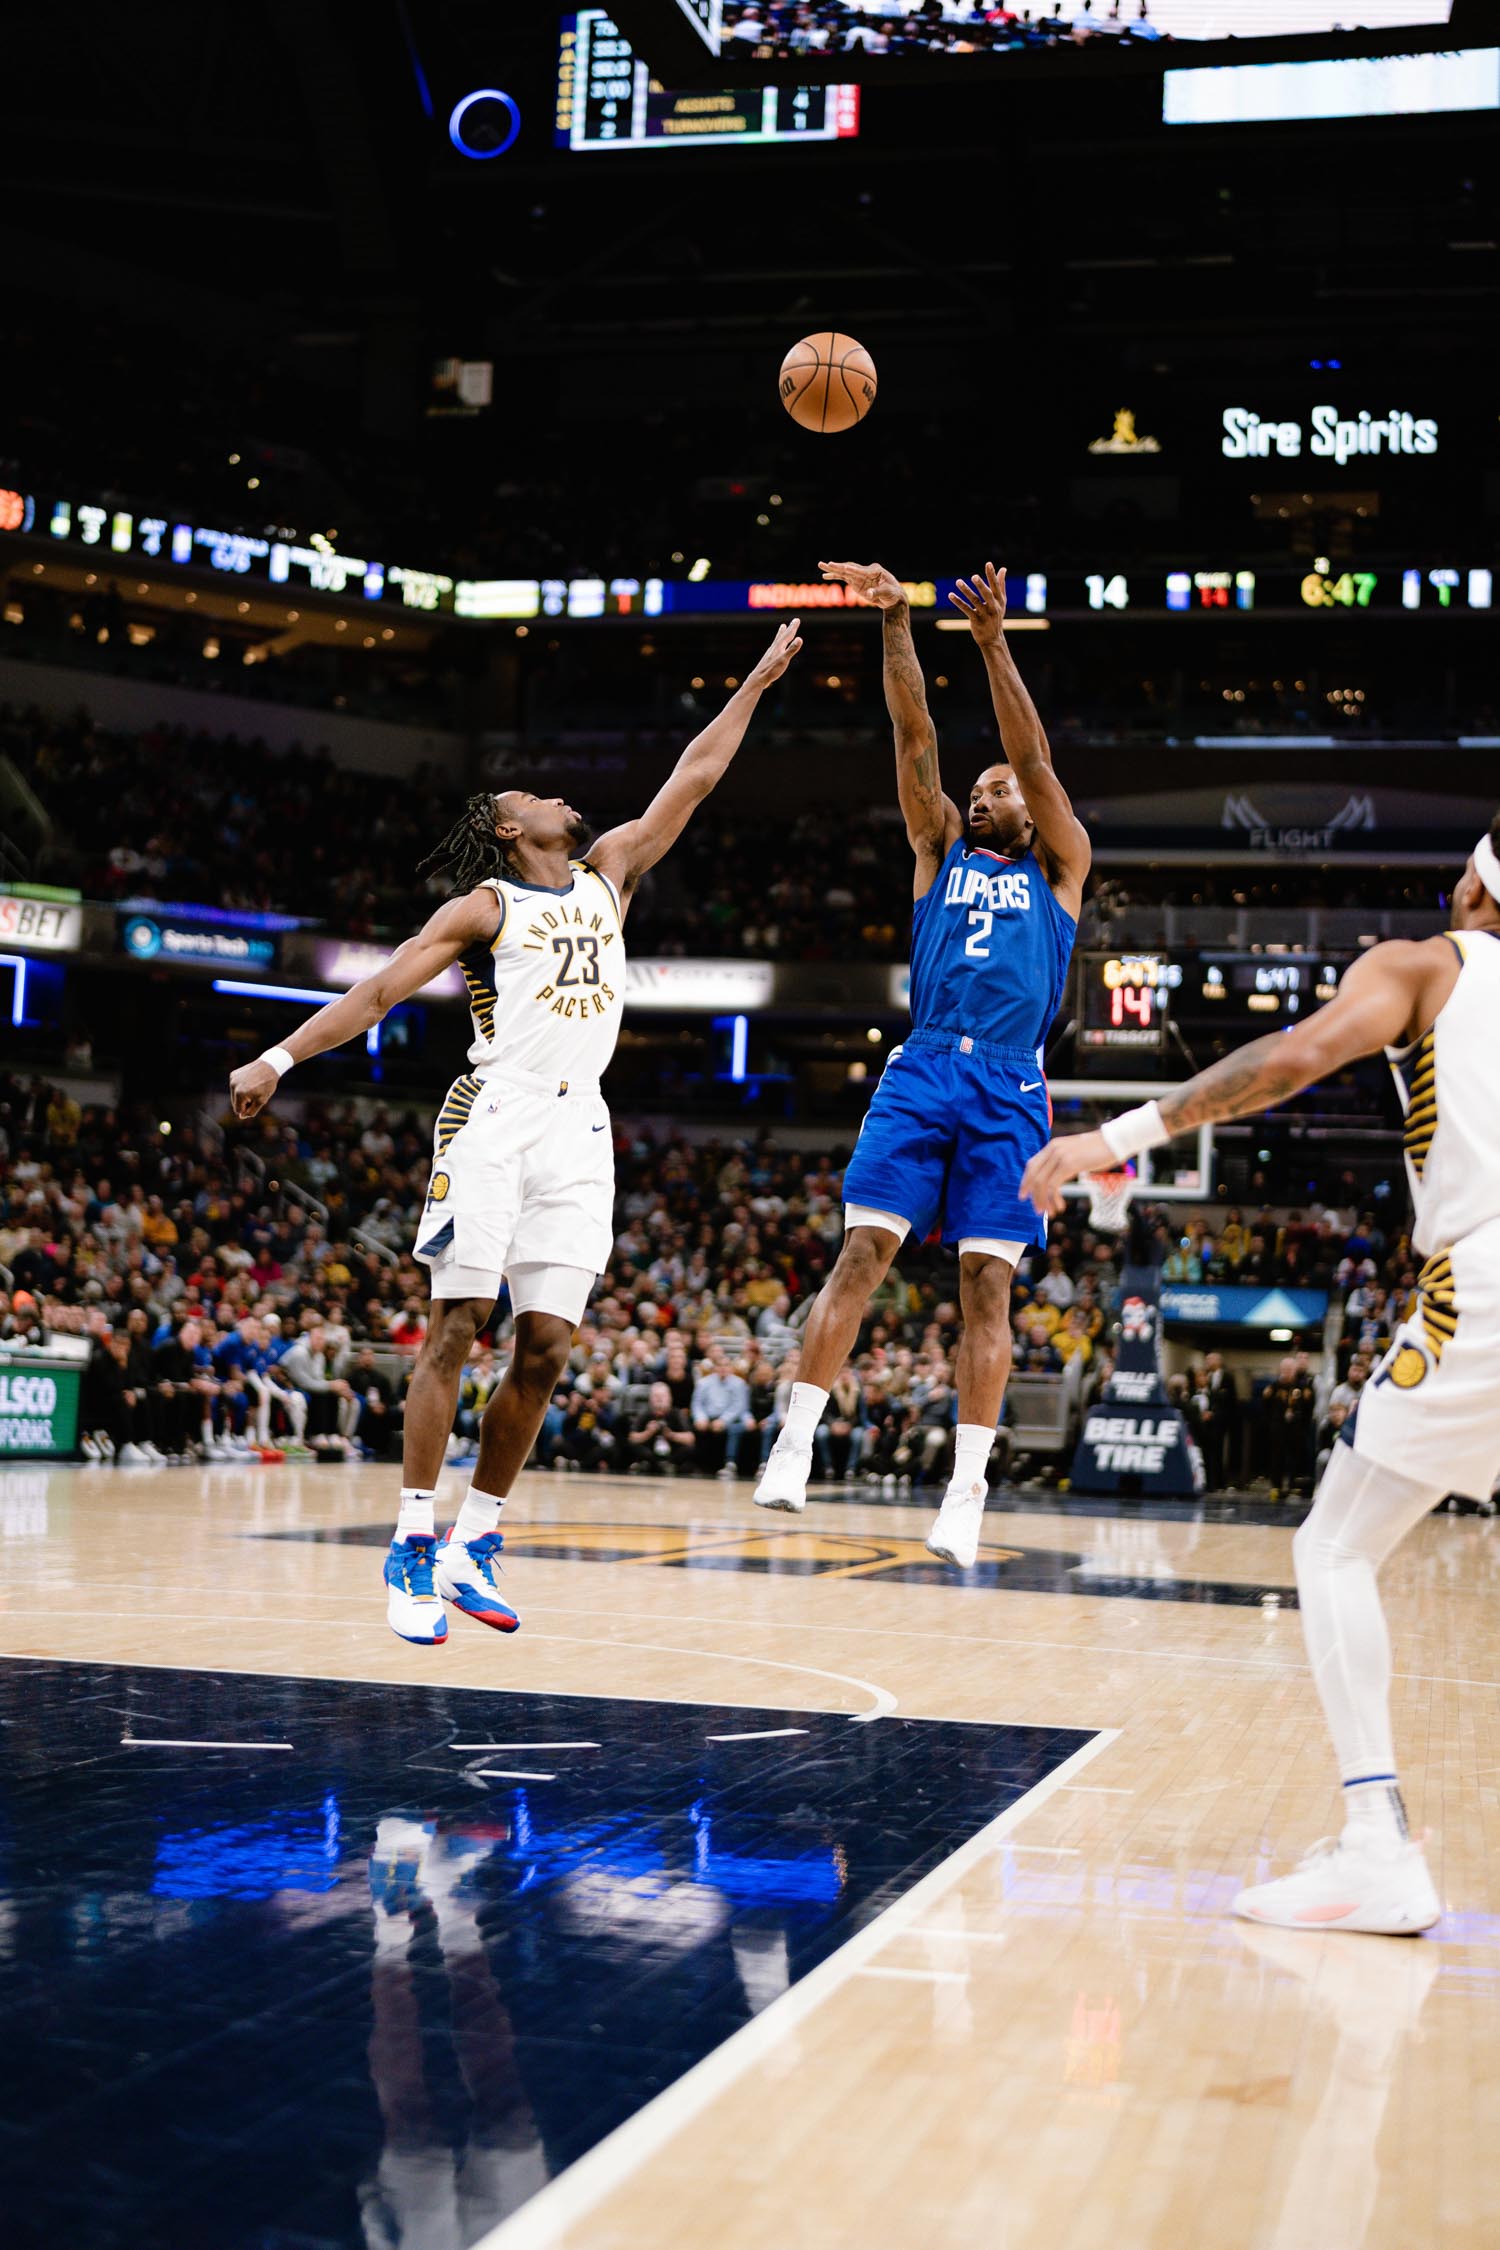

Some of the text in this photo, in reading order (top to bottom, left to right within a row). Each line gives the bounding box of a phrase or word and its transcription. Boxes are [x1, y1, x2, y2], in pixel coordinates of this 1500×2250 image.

[1222, 405, 1438, 466] Sire Spirits
[1085, 574, 1129, 610] 14
[1301, 573, 1377, 608] 6:47
[1250, 828, 1334, 848] FLIGHT
[522, 905, 614, 951] INDIANA
[965, 910, 993, 957] 2
[552, 936, 600, 987] 23
[536, 982, 615, 1019] PACERS
[1111, 986, 1151, 1027] 14
[1111, 1371, 1158, 1385] BELLE
[1116, 1385, 1151, 1399] TIRE
[1084, 1417, 1181, 1447] BELLE
[1094, 1443, 1167, 1473] TIRE
